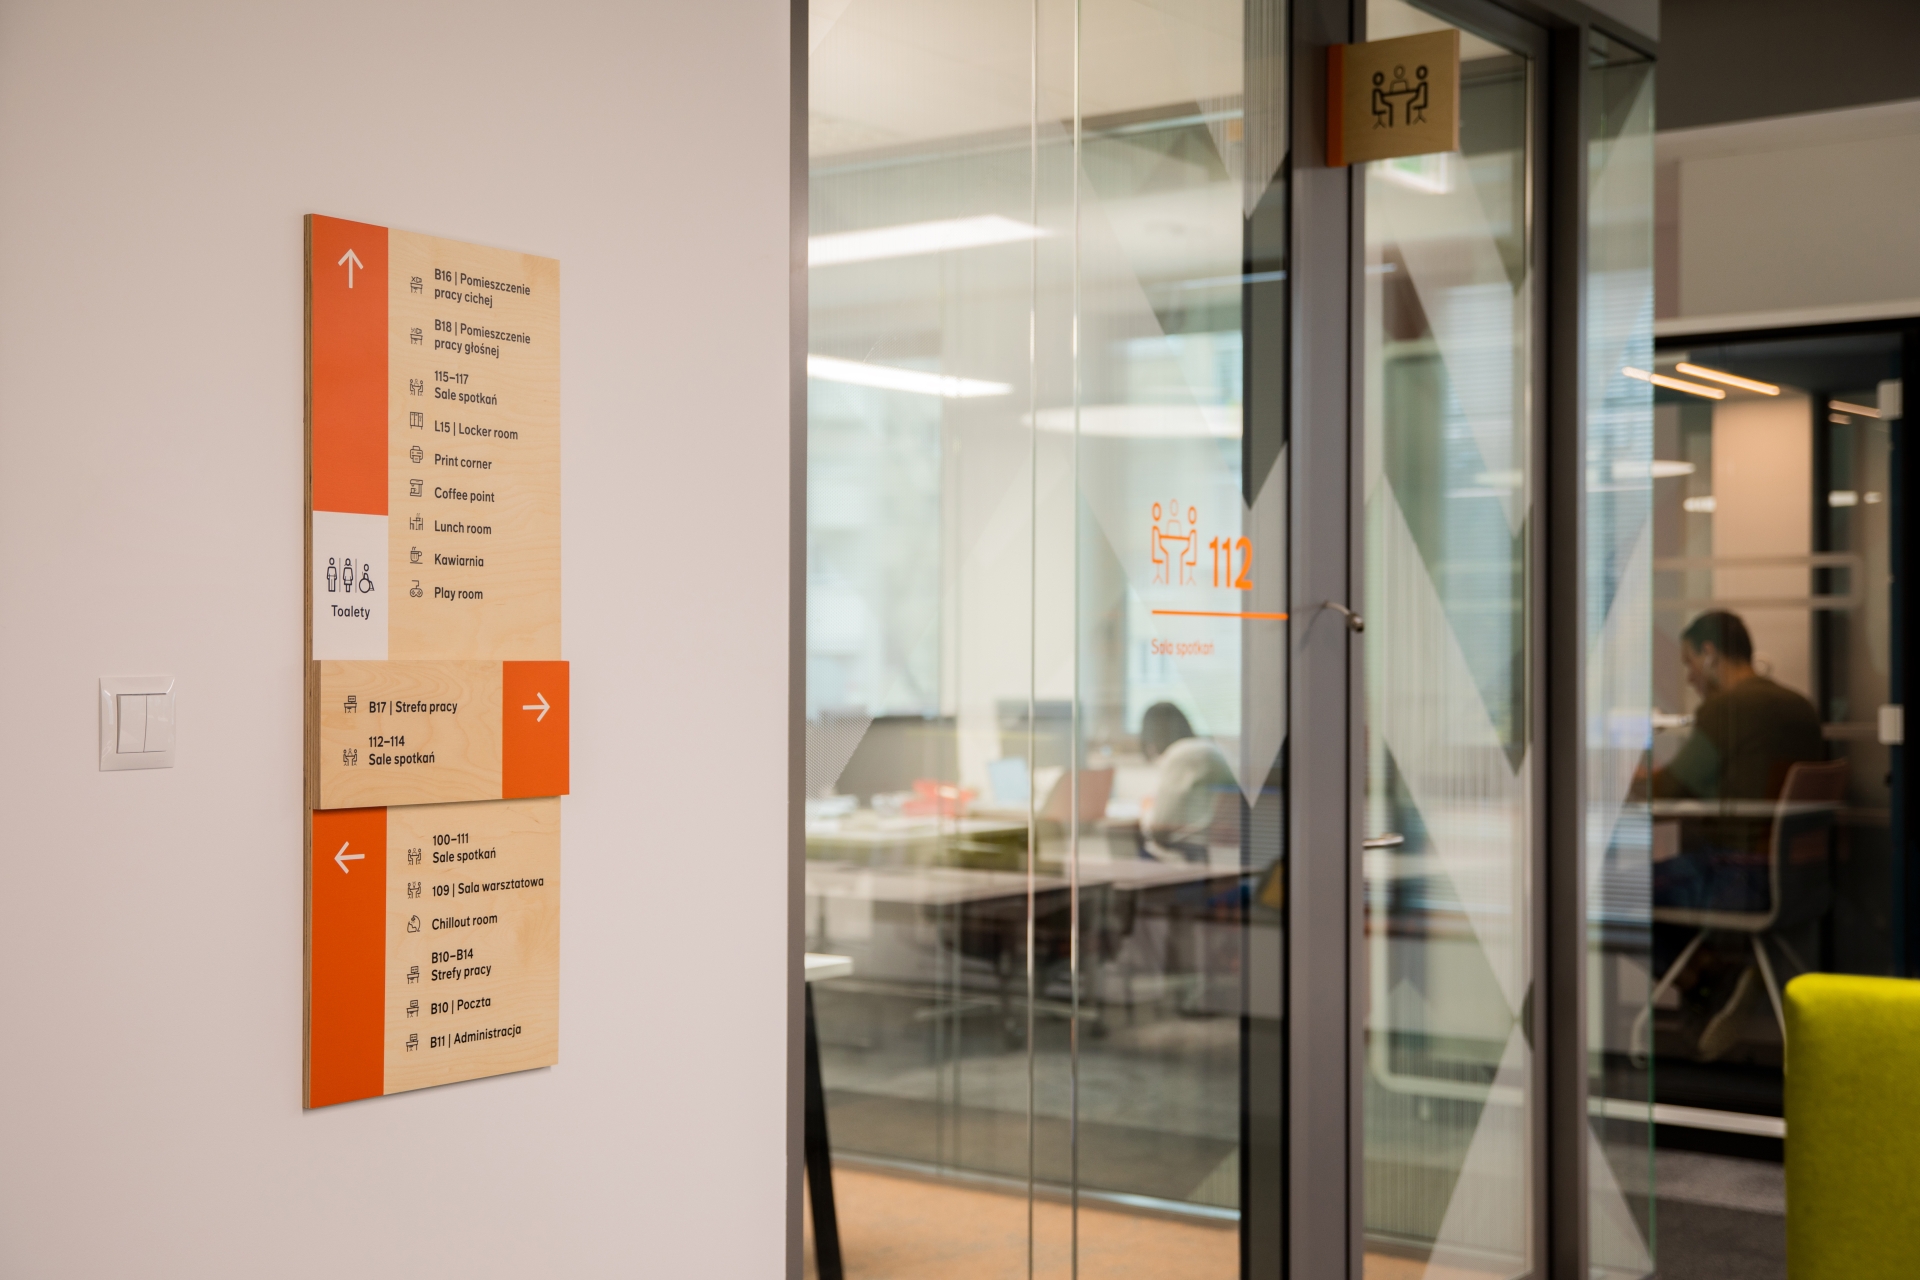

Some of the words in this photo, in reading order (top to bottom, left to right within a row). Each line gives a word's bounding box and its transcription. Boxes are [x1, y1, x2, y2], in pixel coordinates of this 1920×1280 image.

[435, 268, 452, 282] B16
[460, 273, 530, 295] Pomieszczenie
[435, 288, 462, 303] pracy
[465, 292, 492, 308] cichej
[435, 319, 452, 332] B18
[460, 323, 530, 344] Pomieszczenie
[435, 338, 462, 353] pracy
[465, 341, 499, 358] głośnej
[435, 387, 456, 400] Sale
[459, 391, 497, 405] spotkań
[435, 421, 450, 433] L15
[459, 423, 491, 437] Locker
[494, 427, 518, 439] room
[435, 454, 458, 467] Print
[461, 458, 492, 469] corner
[435, 487, 467, 500] Coffee
[470, 490, 495, 503] point
[435, 520, 464, 533] Lunch
[467, 524, 491, 534] room
[435, 554, 484, 567] Kawiarnia
[1209, 536, 1253, 590] 112
[435, 587, 455, 601] Play
[458, 589, 483, 599] room
[331, 605, 370, 620] Toalety
[369, 701, 386, 713] B17
[395, 701, 427, 713] Strefa
[430, 702, 457, 715] pracy
[369, 754, 391, 765] Sale
[394, 752, 435, 767] spotkań
[433, 851, 454, 863] Sale
[456, 847, 496, 862] spotkań
[432, 885, 449, 896] 109
[458, 882, 479, 894] Sala
[482, 876, 544, 893] warsztatowa
[432, 917, 470, 930] Chillout
[473, 914, 497, 926] room
[432, 967, 461, 981] Strefy
[464, 964, 492, 978] pracy
[431, 1002, 448, 1015] B10
[457, 997, 491, 1011] Poczta
[430, 1036, 445, 1048] B11
[454, 1024, 521, 1045] Administracja
